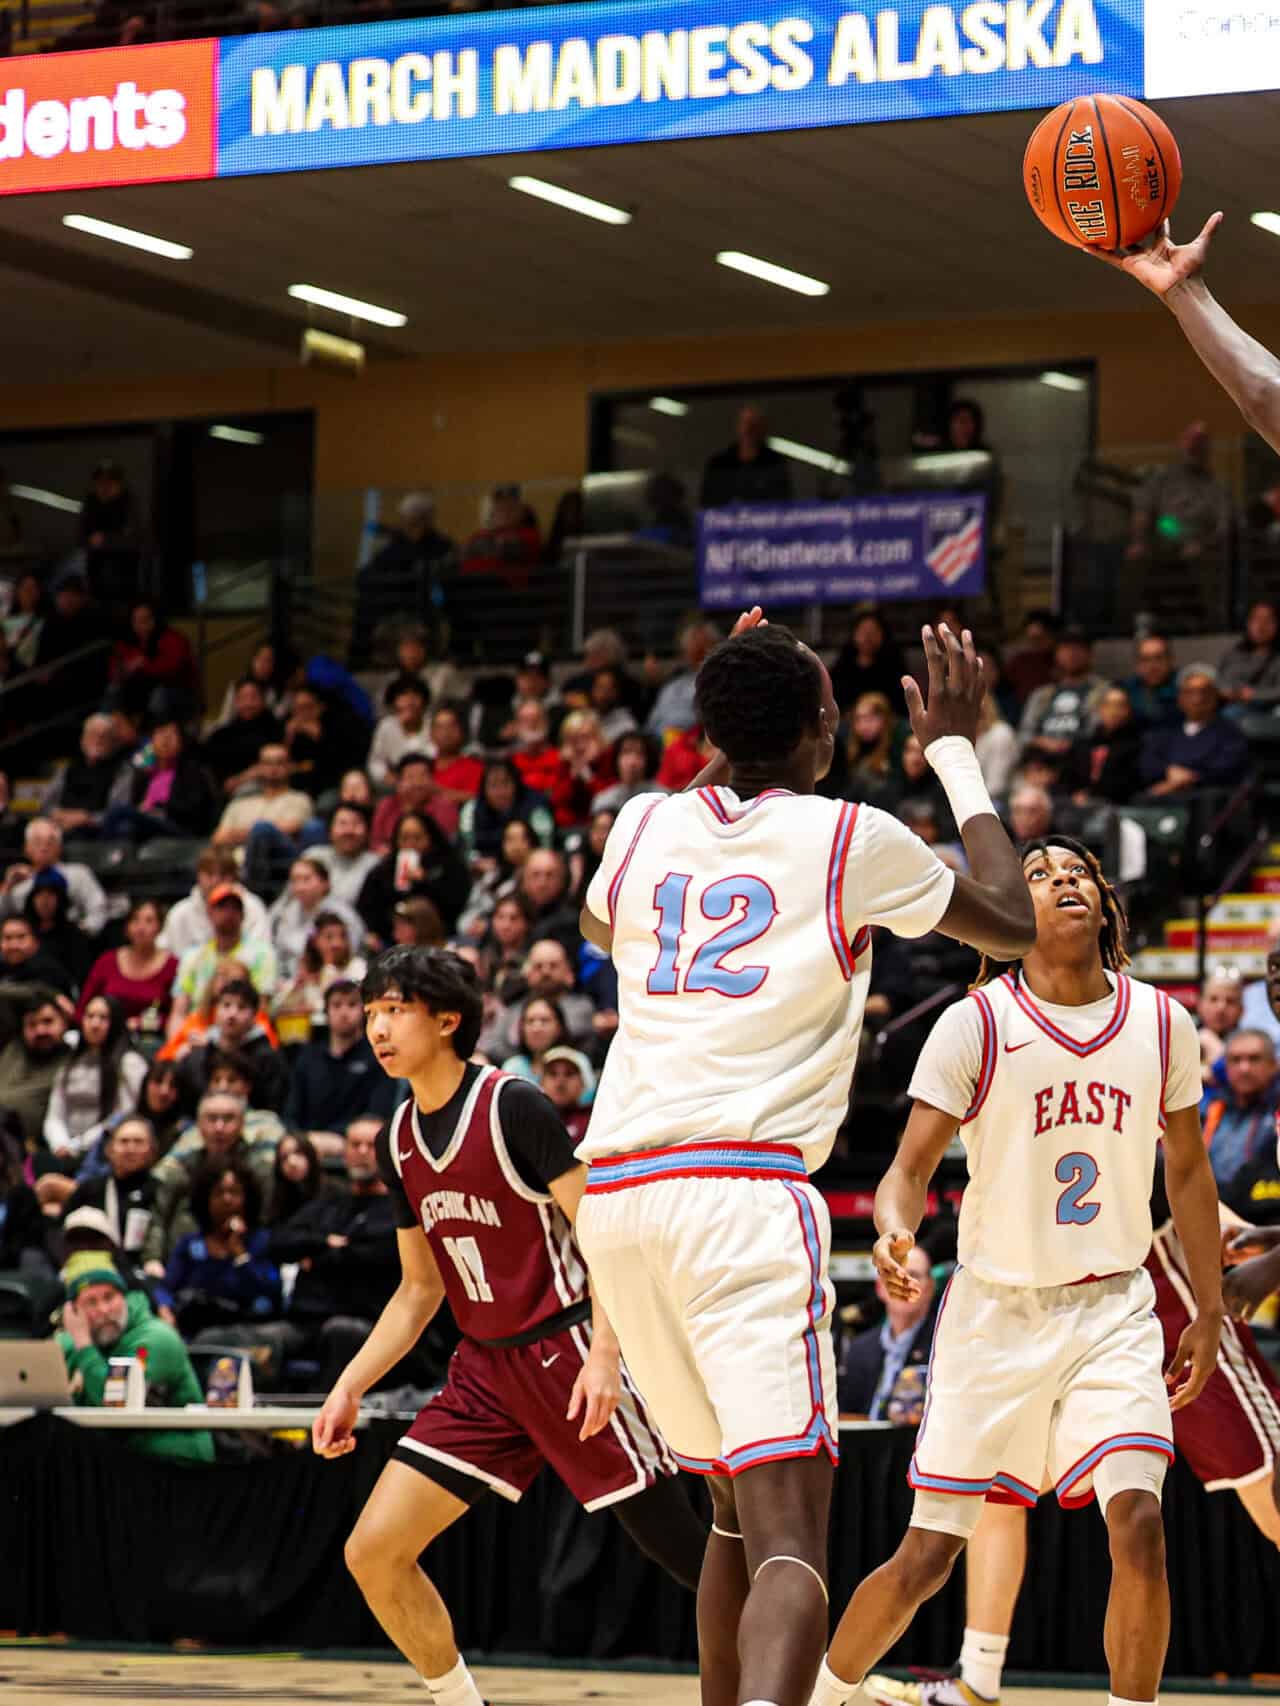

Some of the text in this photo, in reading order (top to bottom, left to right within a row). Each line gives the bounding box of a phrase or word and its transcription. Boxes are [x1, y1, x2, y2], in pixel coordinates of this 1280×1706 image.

[250, 0, 1105, 136] MARCH MADNESS ALASKA
[1064, 126, 1108, 240] THE ROCK
[646, 871, 781, 999] 12
[1033, 1080, 1132, 1138] EAST
[1055, 1151, 1101, 1226] 2
